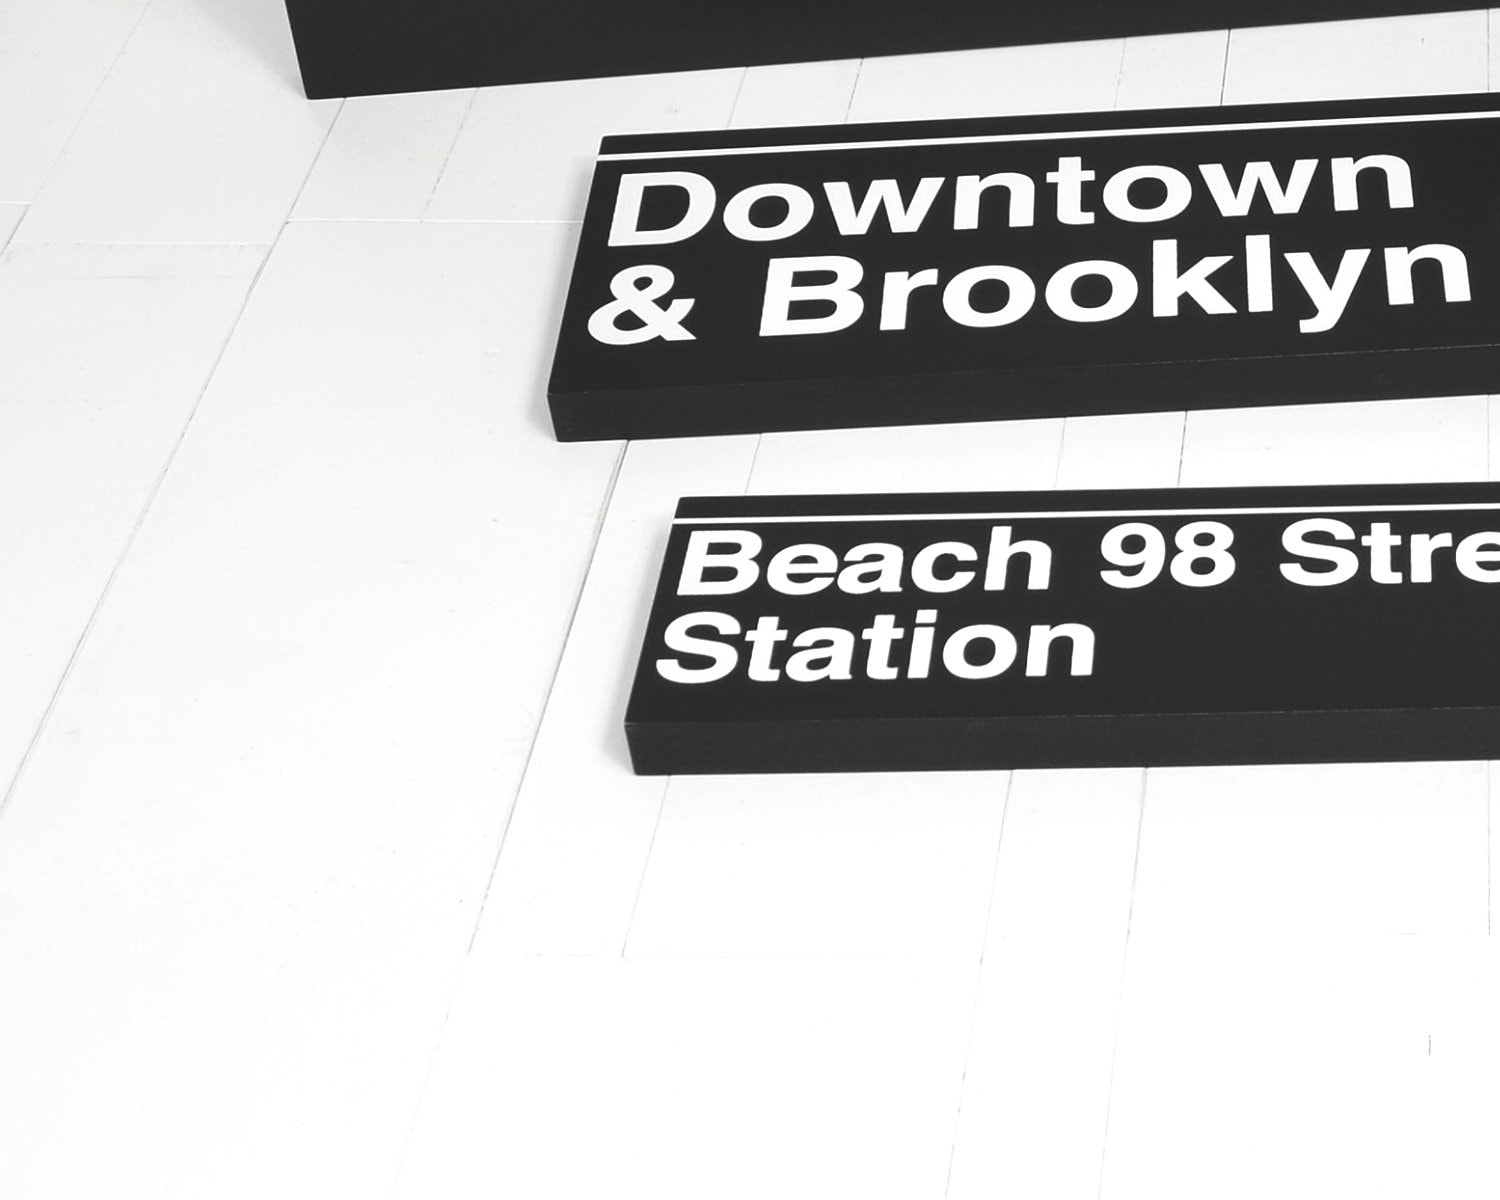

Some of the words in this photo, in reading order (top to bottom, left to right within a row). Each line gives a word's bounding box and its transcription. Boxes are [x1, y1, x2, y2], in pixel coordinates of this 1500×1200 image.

[607, 154, 1415, 247] Downtown
[587, 265, 697, 346] &
[758, 234, 1472, 337] Brooklyn
[676, 525, 1053, 596] Beach
[1100, 520, 1236, 590] 98
[655, 608, 1096, 685] Station
